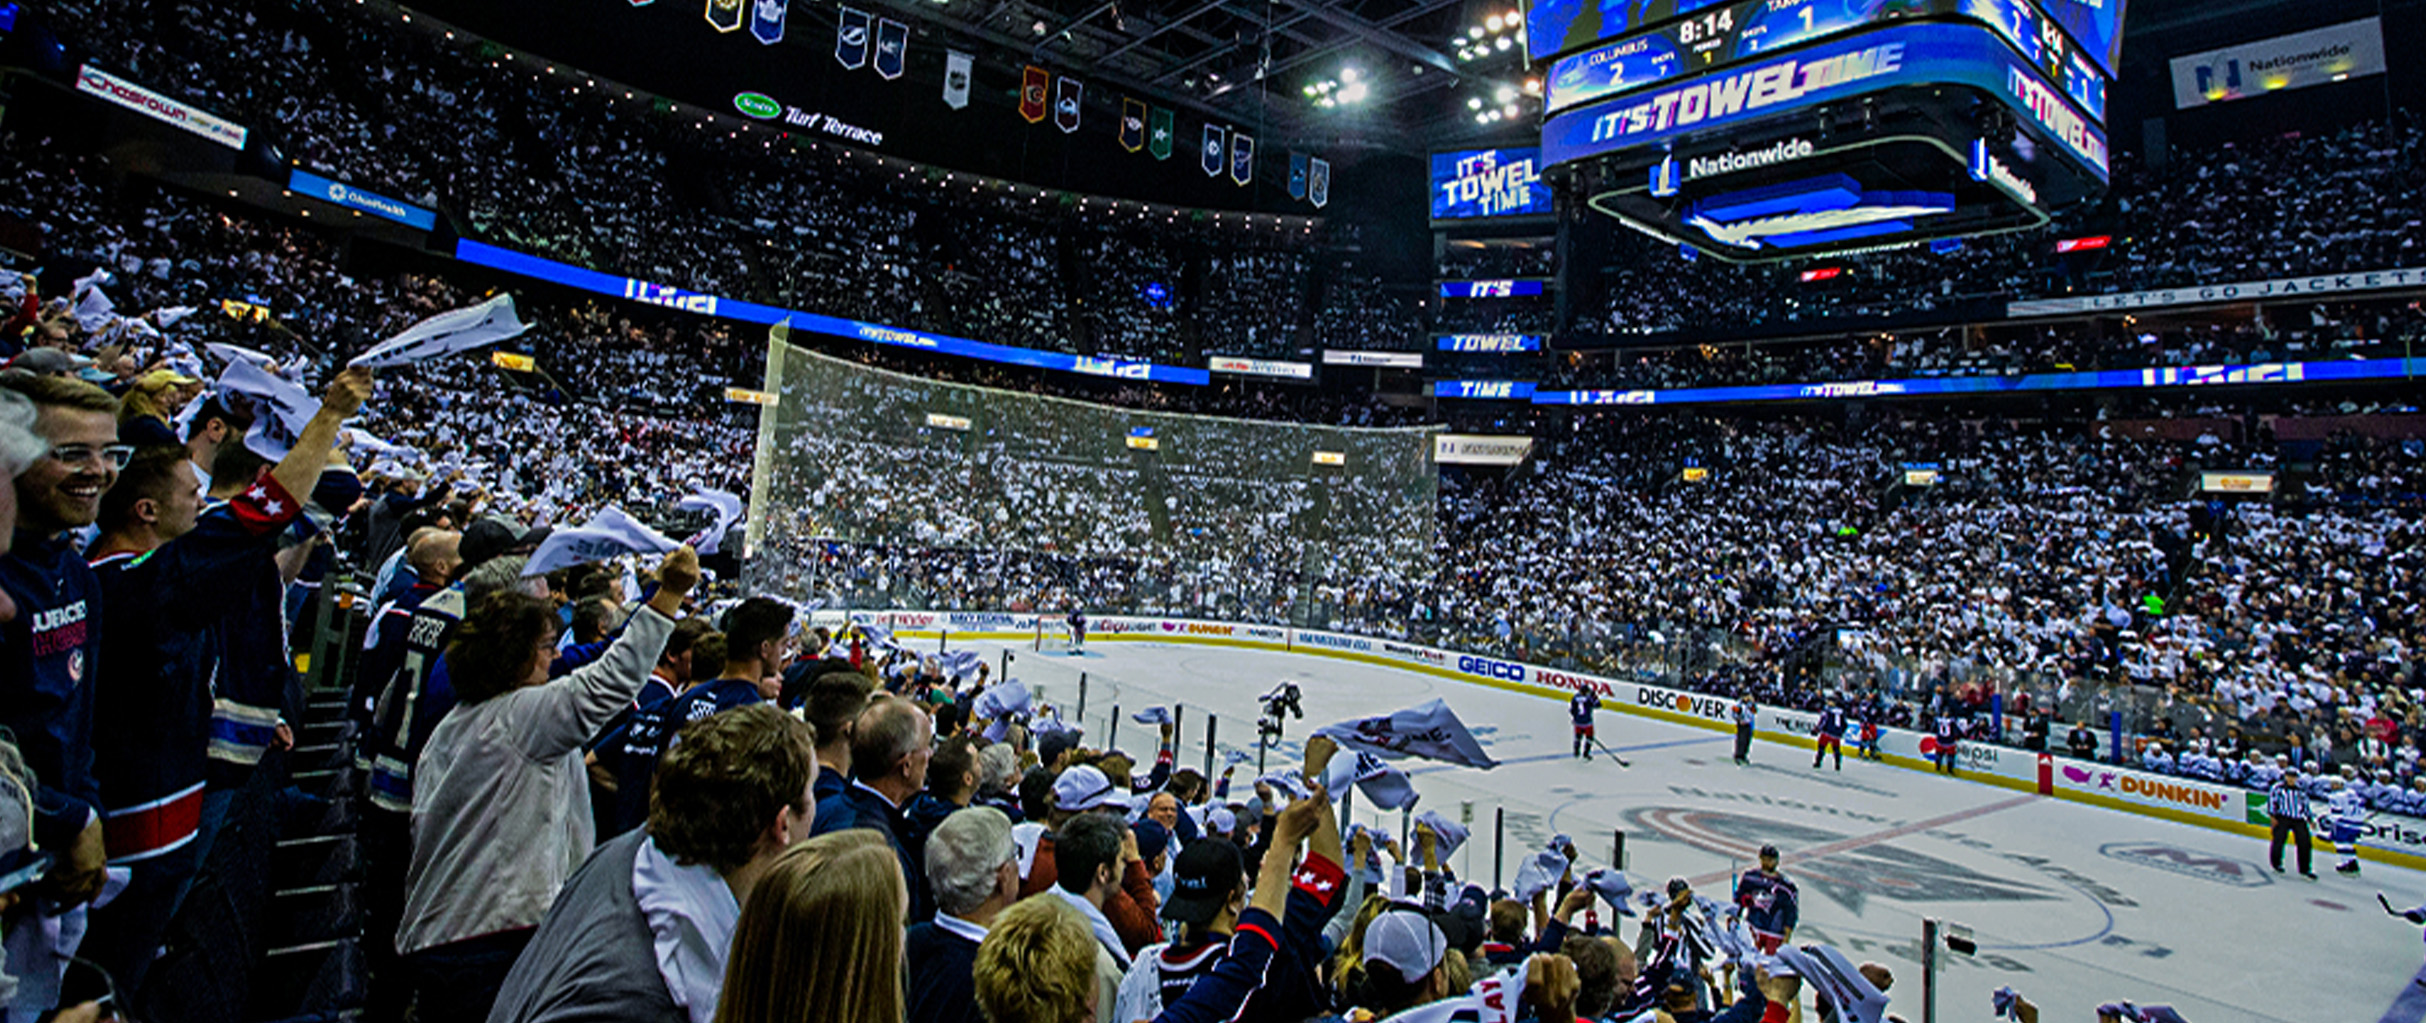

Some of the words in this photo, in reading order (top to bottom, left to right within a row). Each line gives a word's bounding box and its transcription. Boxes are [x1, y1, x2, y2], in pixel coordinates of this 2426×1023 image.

[1680, 9, 1734, 44] 8:14
[1798, 5, 1813, 32] 1
[1590, 38, 1648, 66] COLUMBUS
[1703, 51, 1713, 64] 1
[2249, 44, 2350, 71] Nationwide
[1609, 61, 1625, 86] 2
[785, 105, 822, 129] Turf
[822, 115, 883, 146] Terrace
[1457, 150, 1496, 178] IT'S
[1689, 138, 1812, 178] Nationwide
[1440, 158, 1541, 206] TOWEL
[1478, 186, 1530, 216] TIME
[1470, 281, 1514, 298] IT'S
[2093, 291, 2175, 308] LET'S
[2199, 285, 2239, 301] GO
[1452, 334, 1526, 351] TOWEL
[1460, 381, 1513, 397] TIME
[1458, 655, 1525, 682] GEICO
[1536, 671, 1615, 697] HONDA
[1638, 687, 1726, 719] DISCOVER
